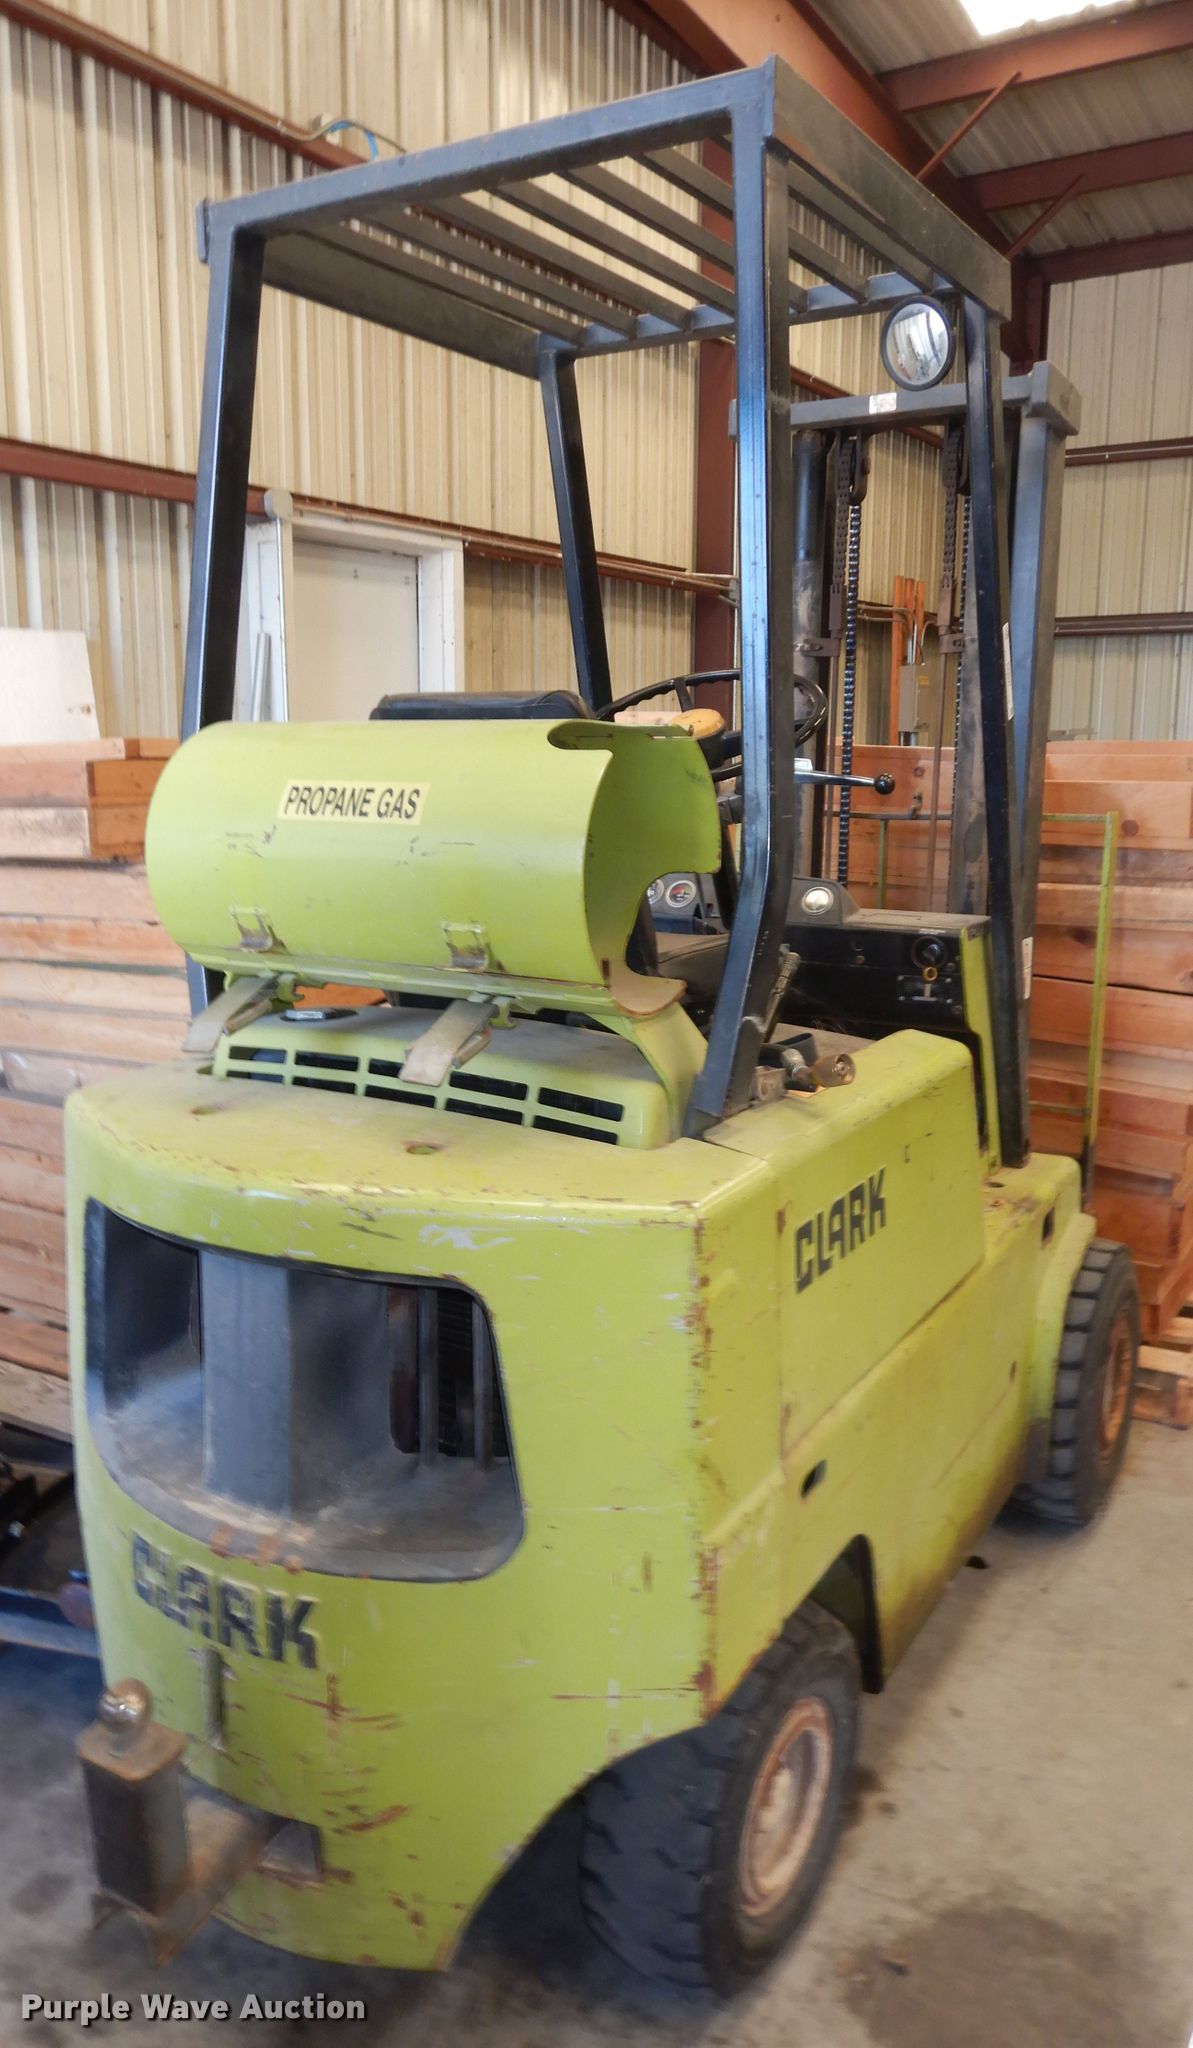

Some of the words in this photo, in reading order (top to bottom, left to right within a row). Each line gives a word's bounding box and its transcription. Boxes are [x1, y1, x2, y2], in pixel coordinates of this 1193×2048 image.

[284, 786, 374, 817] PROPANE
[376, 788, 420, 819] GAS
[796, 1166, 886, 1294] CLARK
[133, 1531, 318, 1669] CLARK
